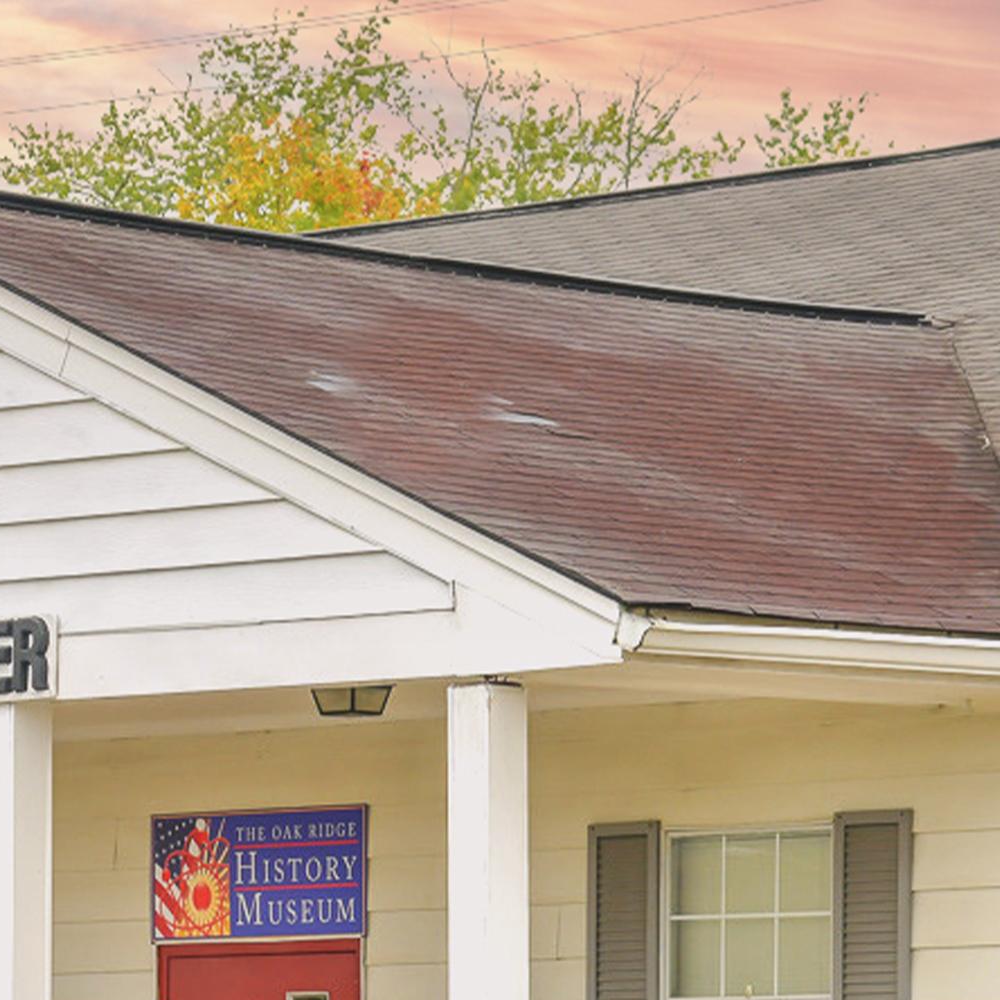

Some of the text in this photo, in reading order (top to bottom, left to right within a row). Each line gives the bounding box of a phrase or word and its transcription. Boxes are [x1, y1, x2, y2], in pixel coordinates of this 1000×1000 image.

[236, 822, 357, 842] THE OAK RIDGE
[234, 851, 357, 885] HISTORY
[236, 892, 356, 926] MUSEUM
